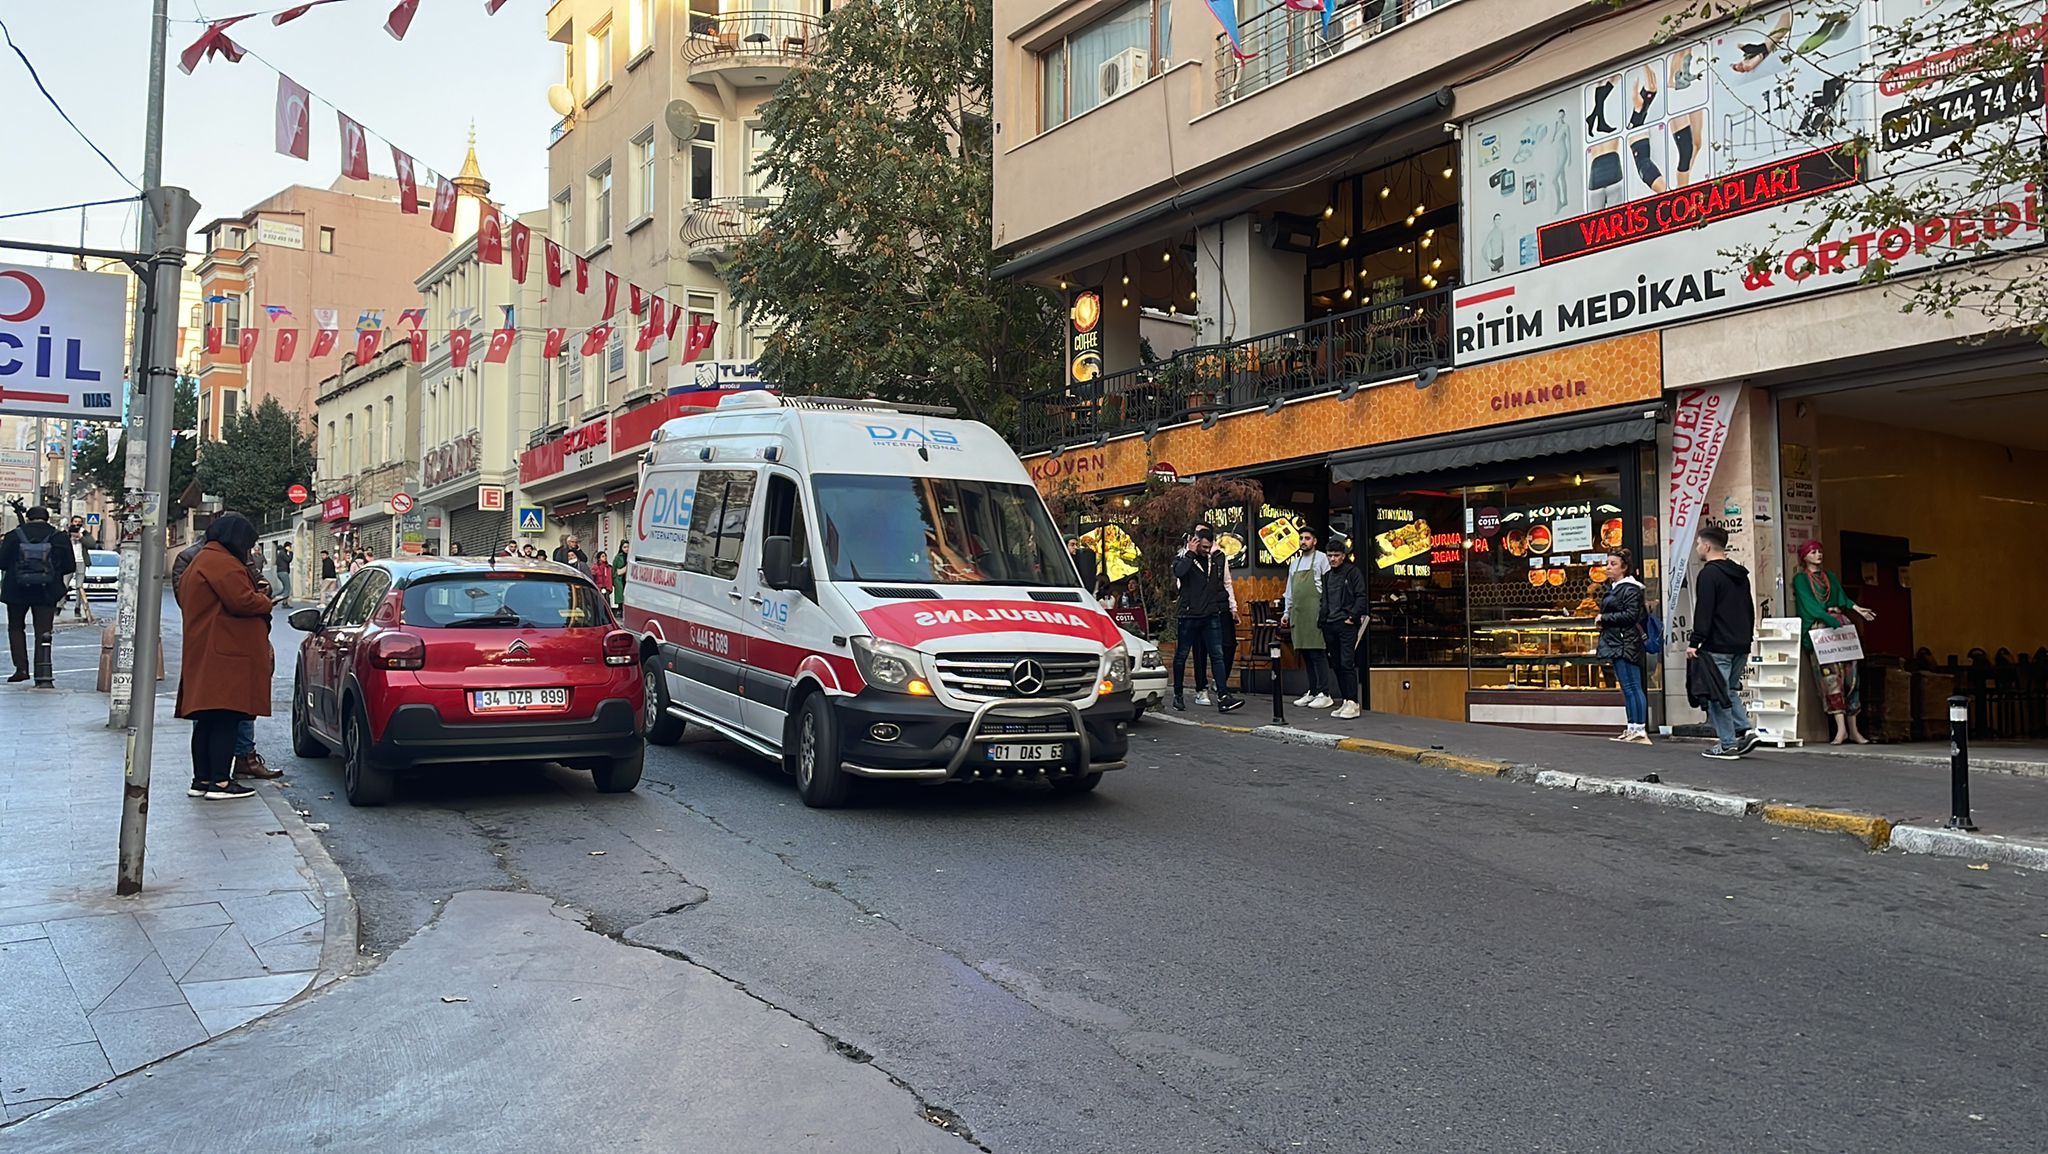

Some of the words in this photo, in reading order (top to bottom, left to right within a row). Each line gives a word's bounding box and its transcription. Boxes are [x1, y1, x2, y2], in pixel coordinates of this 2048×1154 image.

[1939, 93, 1976, 122] 744
[1980, 84, 2006, 116] 74
[1579, 204, 1649, 246] VARİS
[1655, 164, 1801, 230] ÇORAPLARI
[1456, 305, 1542, 354] RİTİM
[1558, 269, 1726, 332] MEDİKAL
[1743, 262, 1776, 291] &
[1784, 181, 2041, 282] ORTOPEDİ
[1074, 331, 1098, 351] COFFEE
[1490, 378, 1587, 412] CİHANGİR
[563, 418, 607, 456] ECZANE
[865, 425, 959, 445] DAS
[873, 440, 963, 452] INTERNATIONAL
[579, 450, 593, 468] ŞULE
[1032, 453, 1105, 481] KOVAN
[1676, 491, 1693, 528] DRY
[1686, 394, 1720, 488] CLEANING
[1694, 419, 1727, 505] LAUNDRY
[486, 491, 498, 505] E
[652, 487, 695, 526] DAS
[1529, 502, 1591, 518] KOVAN
[1478, 518, 1500, 526] COSTA
[649, 530, 687, 543] INTERNATIONAL
[762, 599, 788, 623] DAS
[1115, 614, 1135, 622] COSTA
[696, 627, 708, 648] 444
[709, 631, 715, 651] 5
[715, 632, 729, 656] 689
[113, 675, 132, 685] BOY
[483, 691, 500, 707] 34
[508, 689, 533, 705] DZB
[540, 688, 565, 705] 899
[995, 745, 1009, 760] 01
[1020, 745, 1042, 759] DAS
